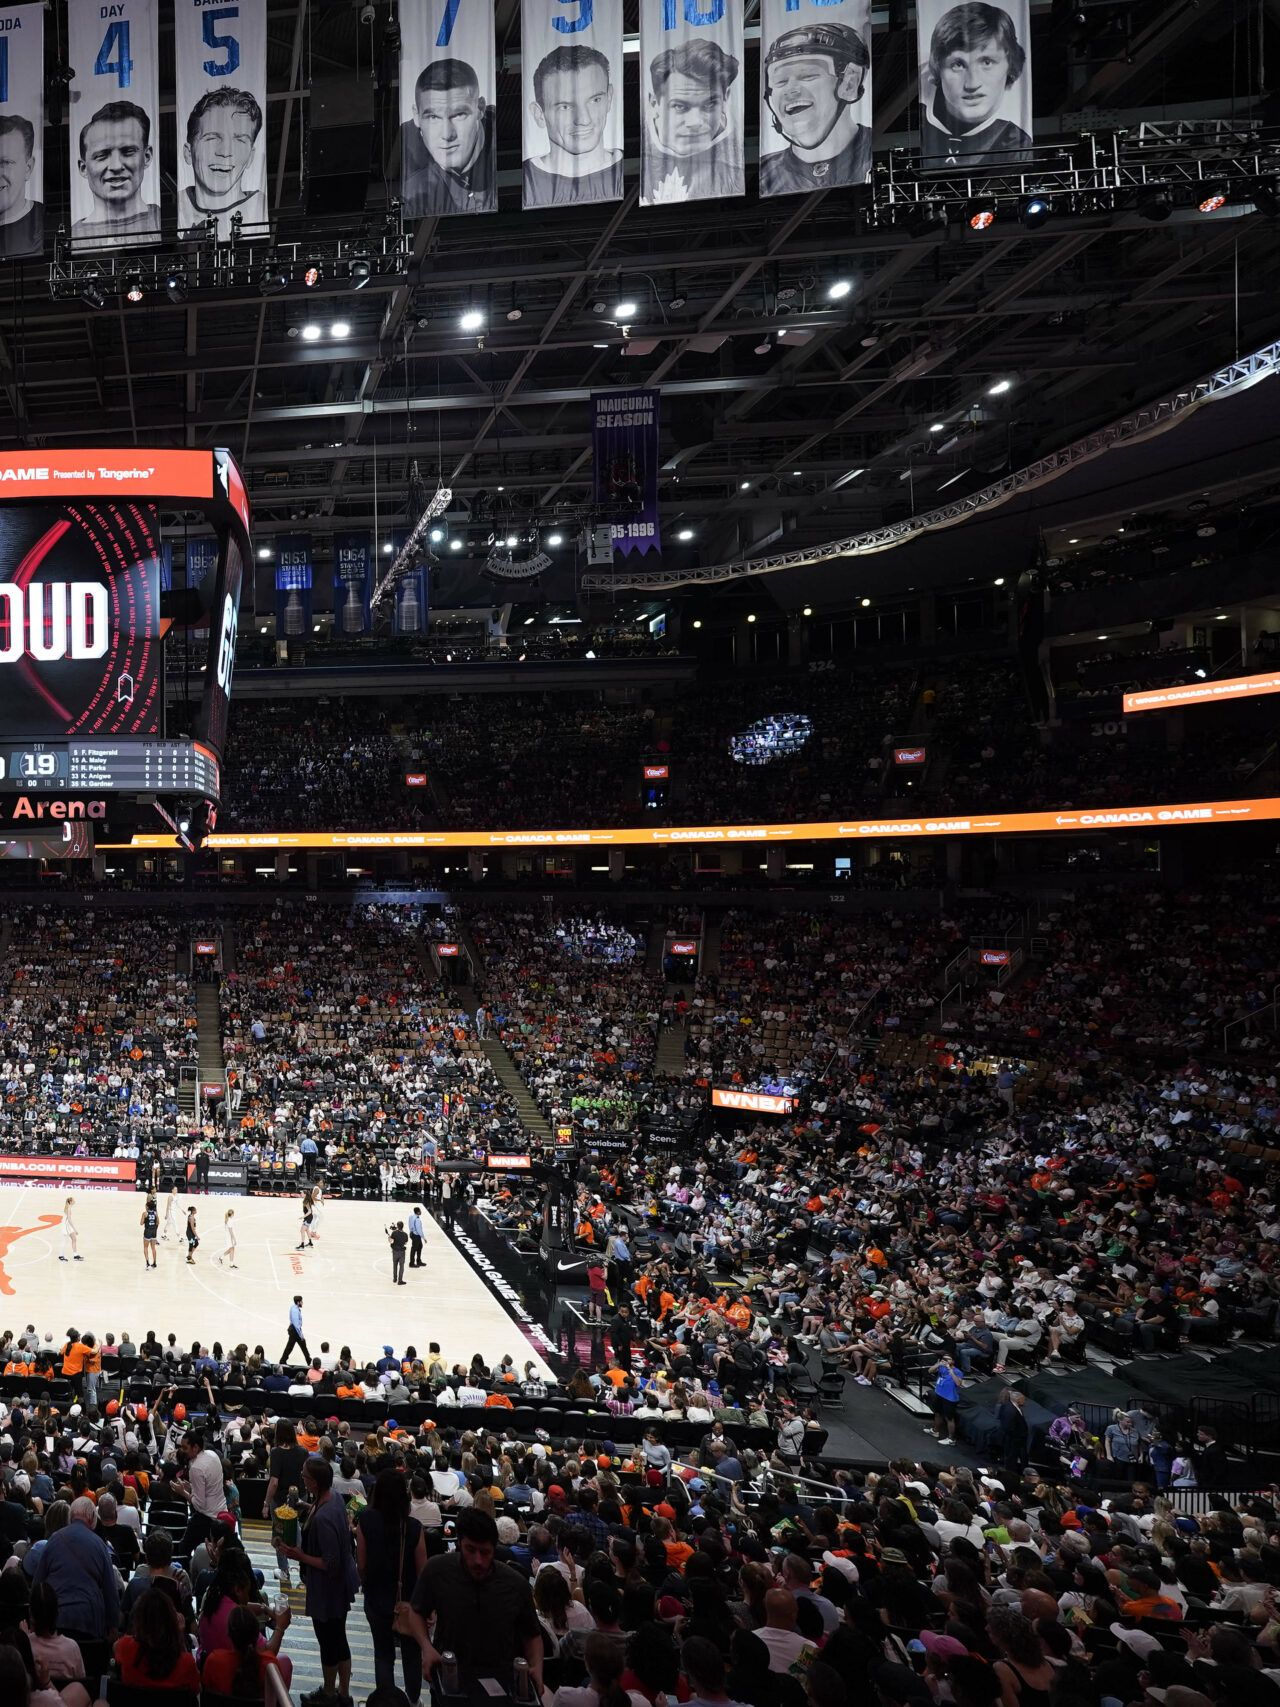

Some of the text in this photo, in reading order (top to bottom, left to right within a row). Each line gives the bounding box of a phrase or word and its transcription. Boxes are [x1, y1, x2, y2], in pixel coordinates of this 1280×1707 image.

[100, 3, 125, 19] DAY
[202, 7, 240, 77] 5
[94, 20, 134, 88] 4
[596, 395, 654, 413] INAUGURAL
[596, 412, 653, 428] SEASON
[53, 470, 86, 479] Presented
[87, 470, 95, 480] by
[97, 468, 149, 481] Tangerine
[281, 551, 306, 565] 1963
[339, 548, 365, 561] 1964
[1090, 720, 1128, 736] 301
[24, 754, 55, 775] 19
[12, 797, 106, 819] Arena
[1080, 808, 1212, 825] CANADA GAME
[858, 821, 970, 833] CANADA GAME
[58, 1164, 83, 1173] FOR
[84, 1165, 119, 1175] MORE
[490, 1157, 527, 1166] WNBA
[457, 1236, 496, 1271] CANADA
[485, 1271, 520, 1300] GAME
